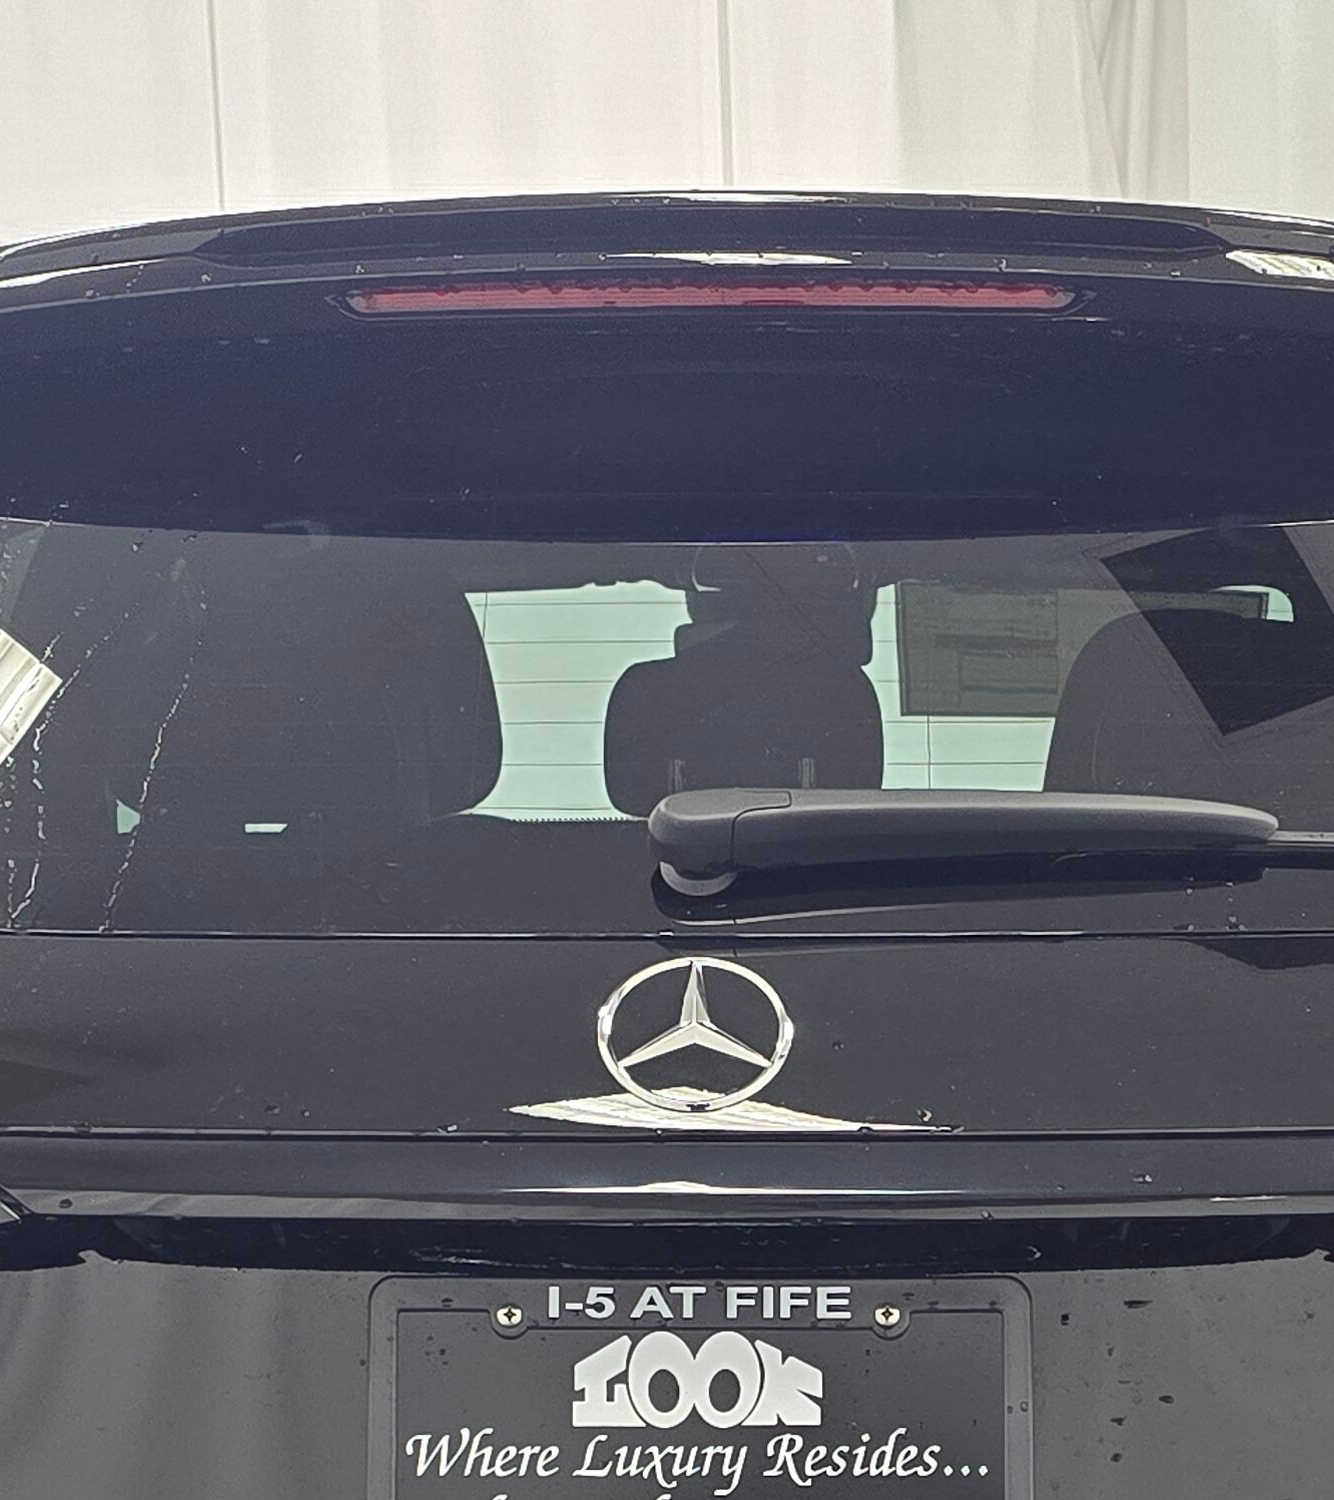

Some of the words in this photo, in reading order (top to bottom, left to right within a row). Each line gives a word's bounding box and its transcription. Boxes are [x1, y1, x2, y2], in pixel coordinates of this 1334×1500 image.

[548, 1286, 616, 1320] I-5
[630, 1286, 706, 1320] AT
[727, 1286, 852, 1320] FIFE
[572, 1330, 823, 1429] LOOK
[405, 1428, 560, 1478] Where
[574, 1434, 748, 1496] Luxury
[764, 1428, 990, 1486] Resides...
